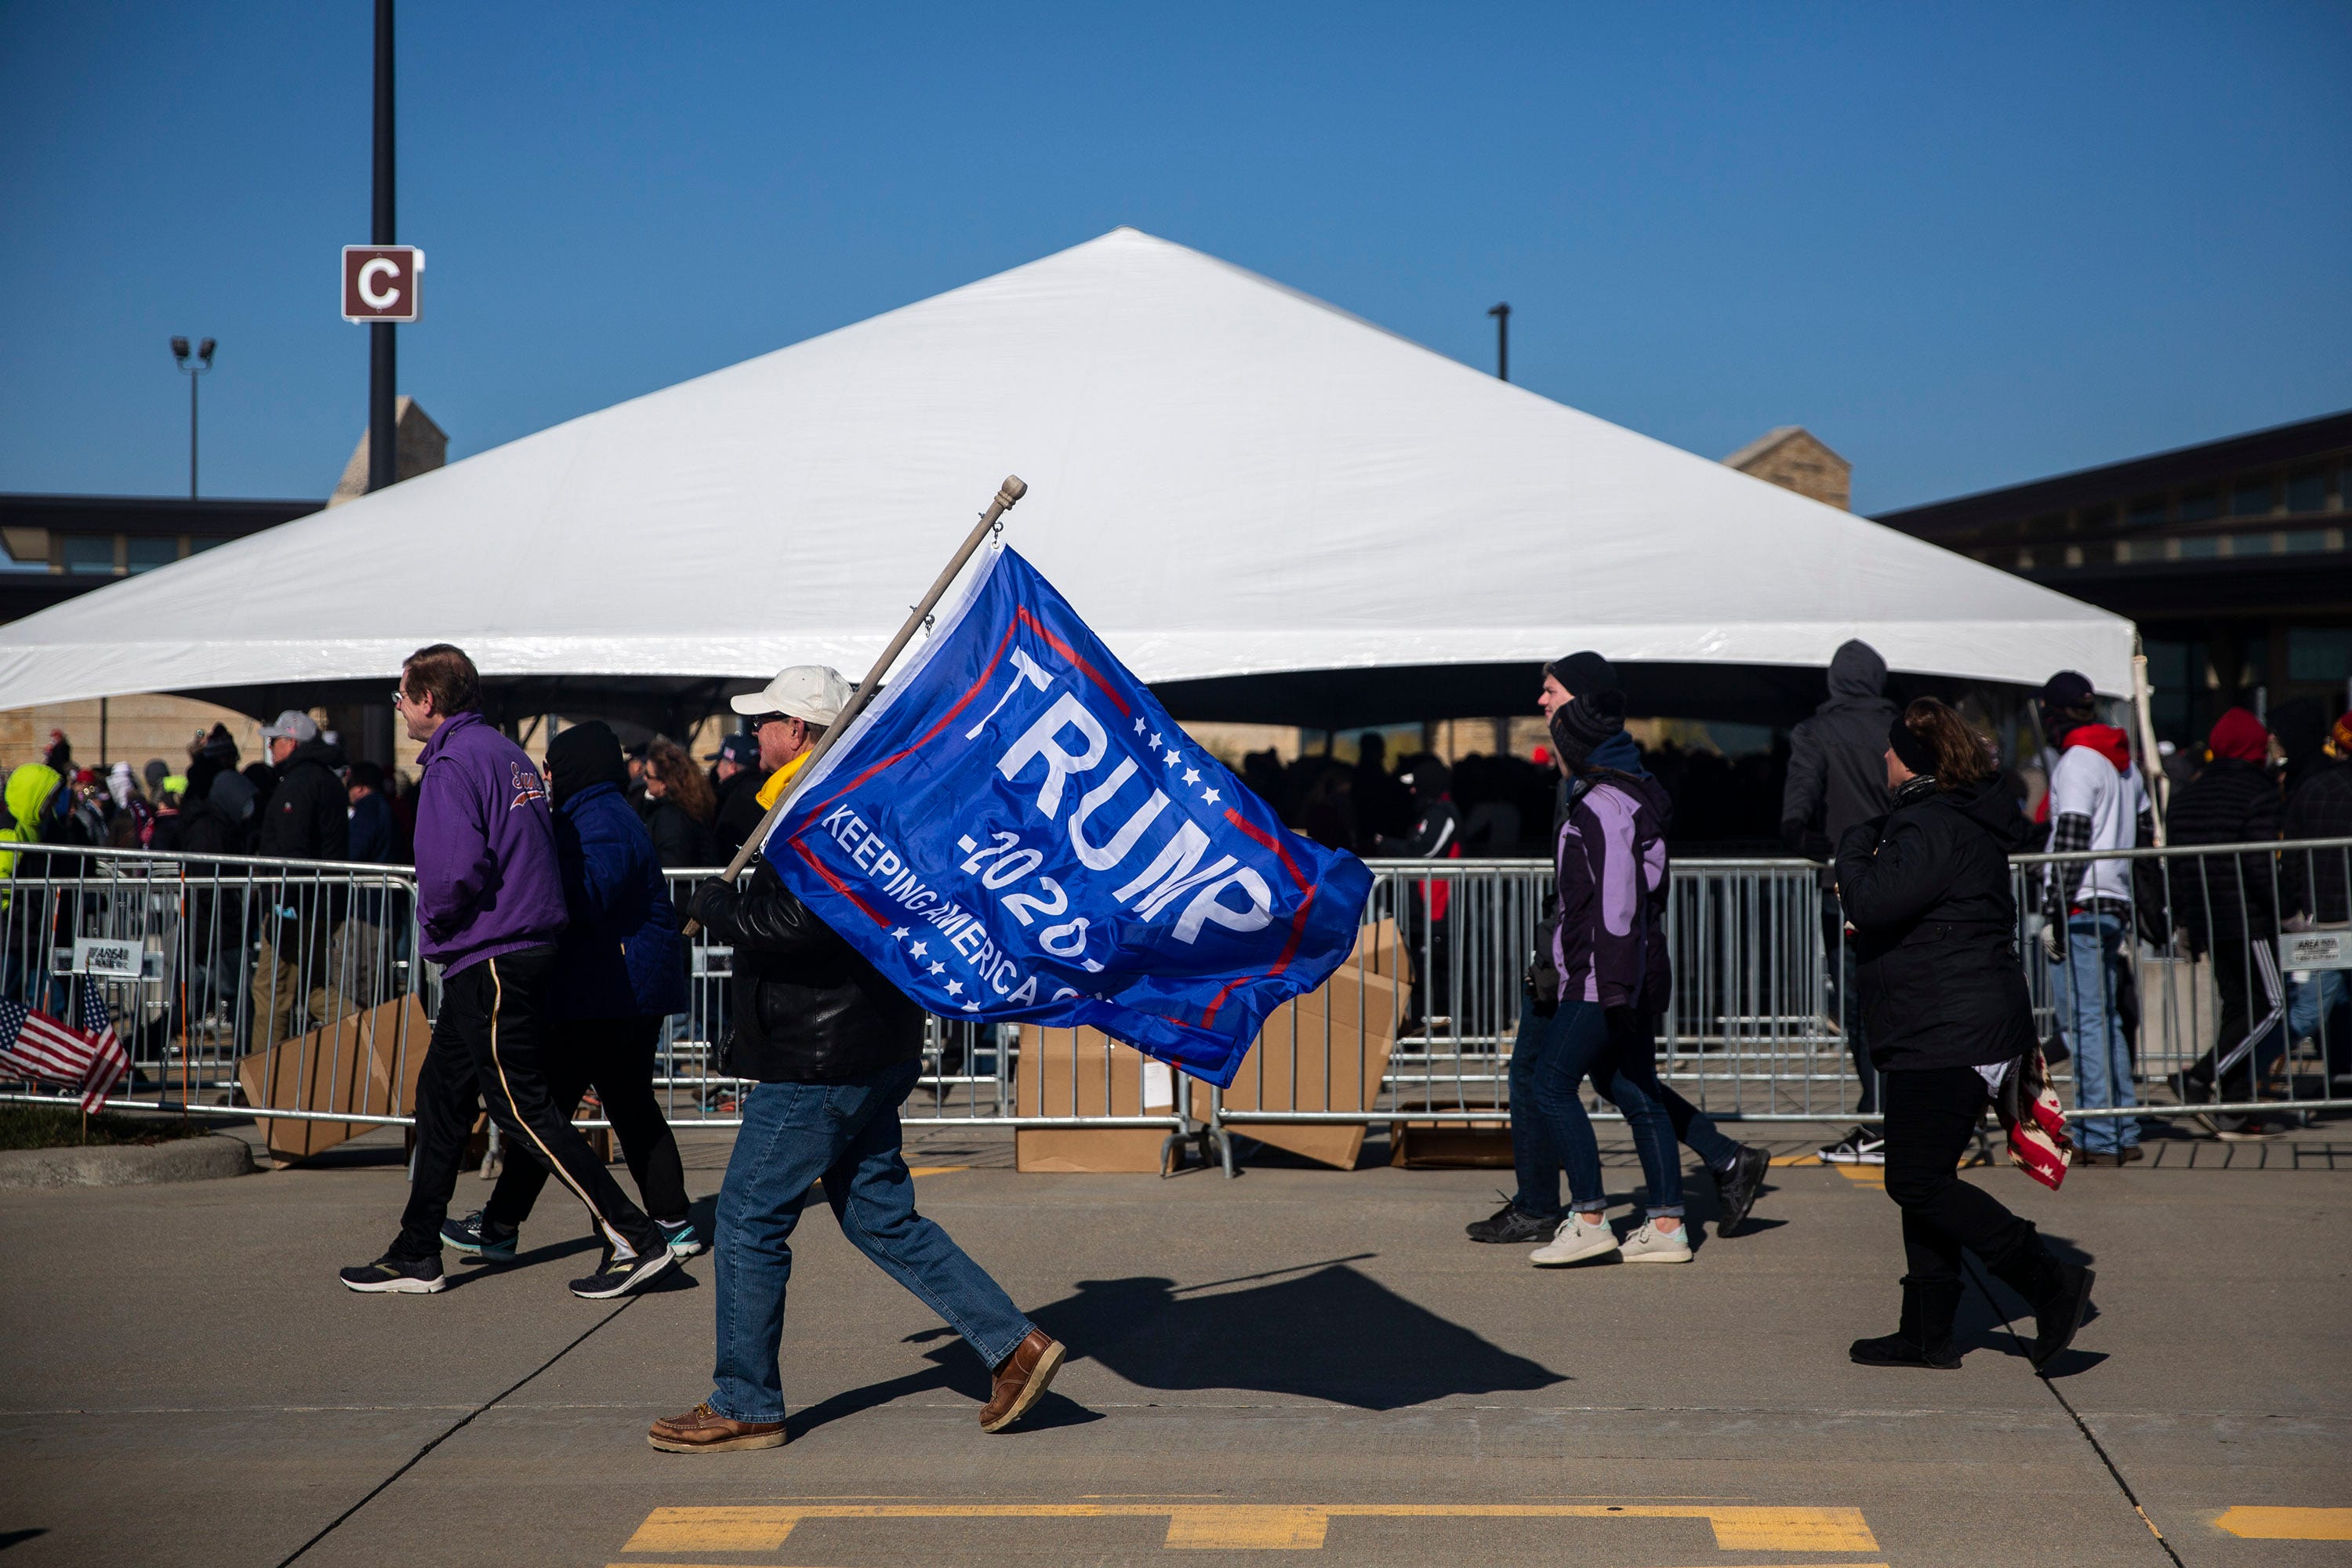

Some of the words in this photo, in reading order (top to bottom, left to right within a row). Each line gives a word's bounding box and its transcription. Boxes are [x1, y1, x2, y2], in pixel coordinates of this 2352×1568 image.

[358, 257, 401, 310] C
[965, 645, 1274, 944] TRUMP
[822, 804, 938, 910] KEEPING
[918, 901, 1037, 1007] AMERICA
